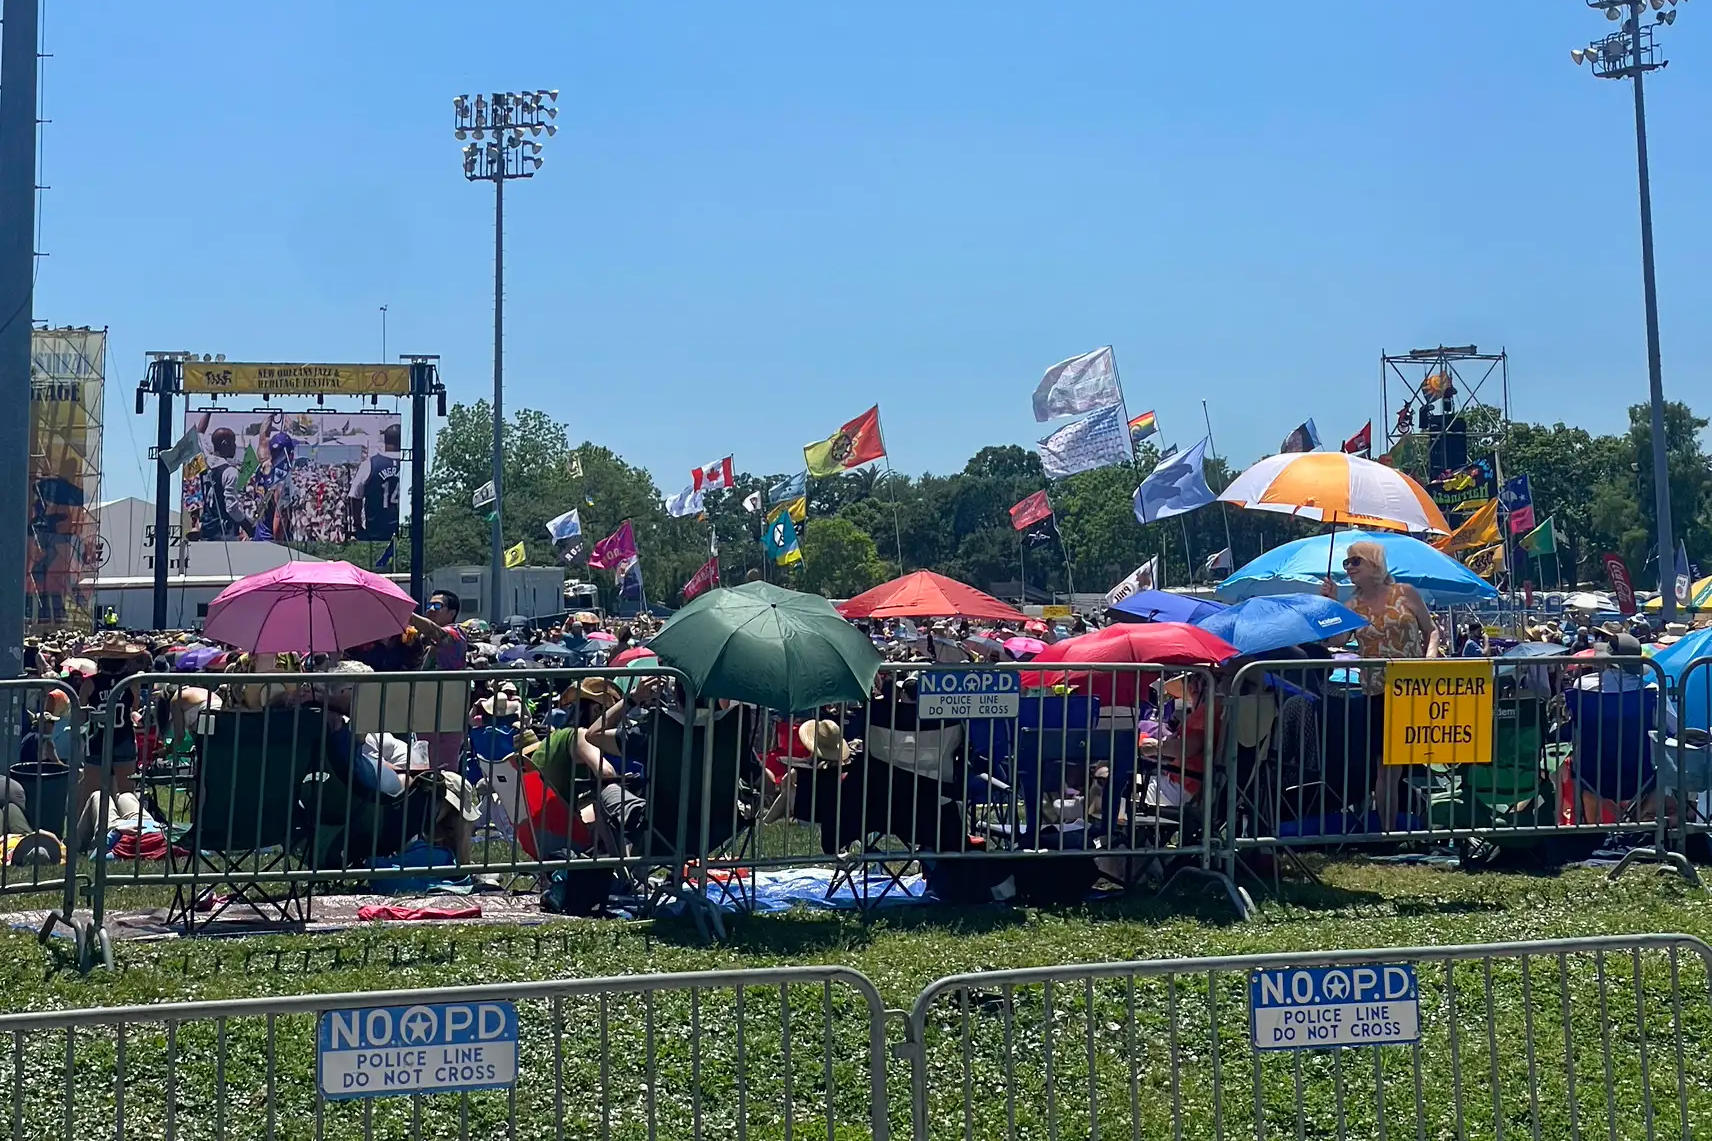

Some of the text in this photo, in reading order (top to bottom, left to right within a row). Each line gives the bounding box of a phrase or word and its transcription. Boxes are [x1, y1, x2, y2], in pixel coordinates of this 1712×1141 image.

[258, 369, 275, 378] NEW
[277, 367, 313, 377] ORLEANS
[314, 367, 332, 377] JAZZ
[258, 377, 340, 388] HERITAGE FESTIVAL
[143, 555, 192, 569] Tnt
[1393, 677, 1485, 696] STAY CLEAR
[940, 695, 999, 705] POLICE LINE
[929, 705, 1009, 715] DO NOT CROSS
[1428, 701, 1450, 720] OF
[1405, 724, 1472, 744] DITCHES
[1284, 1006, 1390, 1024] POLICE LINE
[1273, 1021, 1401, 1042] DO NOT CROSS
[356, 1047, 484, 1069] POLICE LINE
[343, 1064, 496, 1088] DO NOT CROSS
